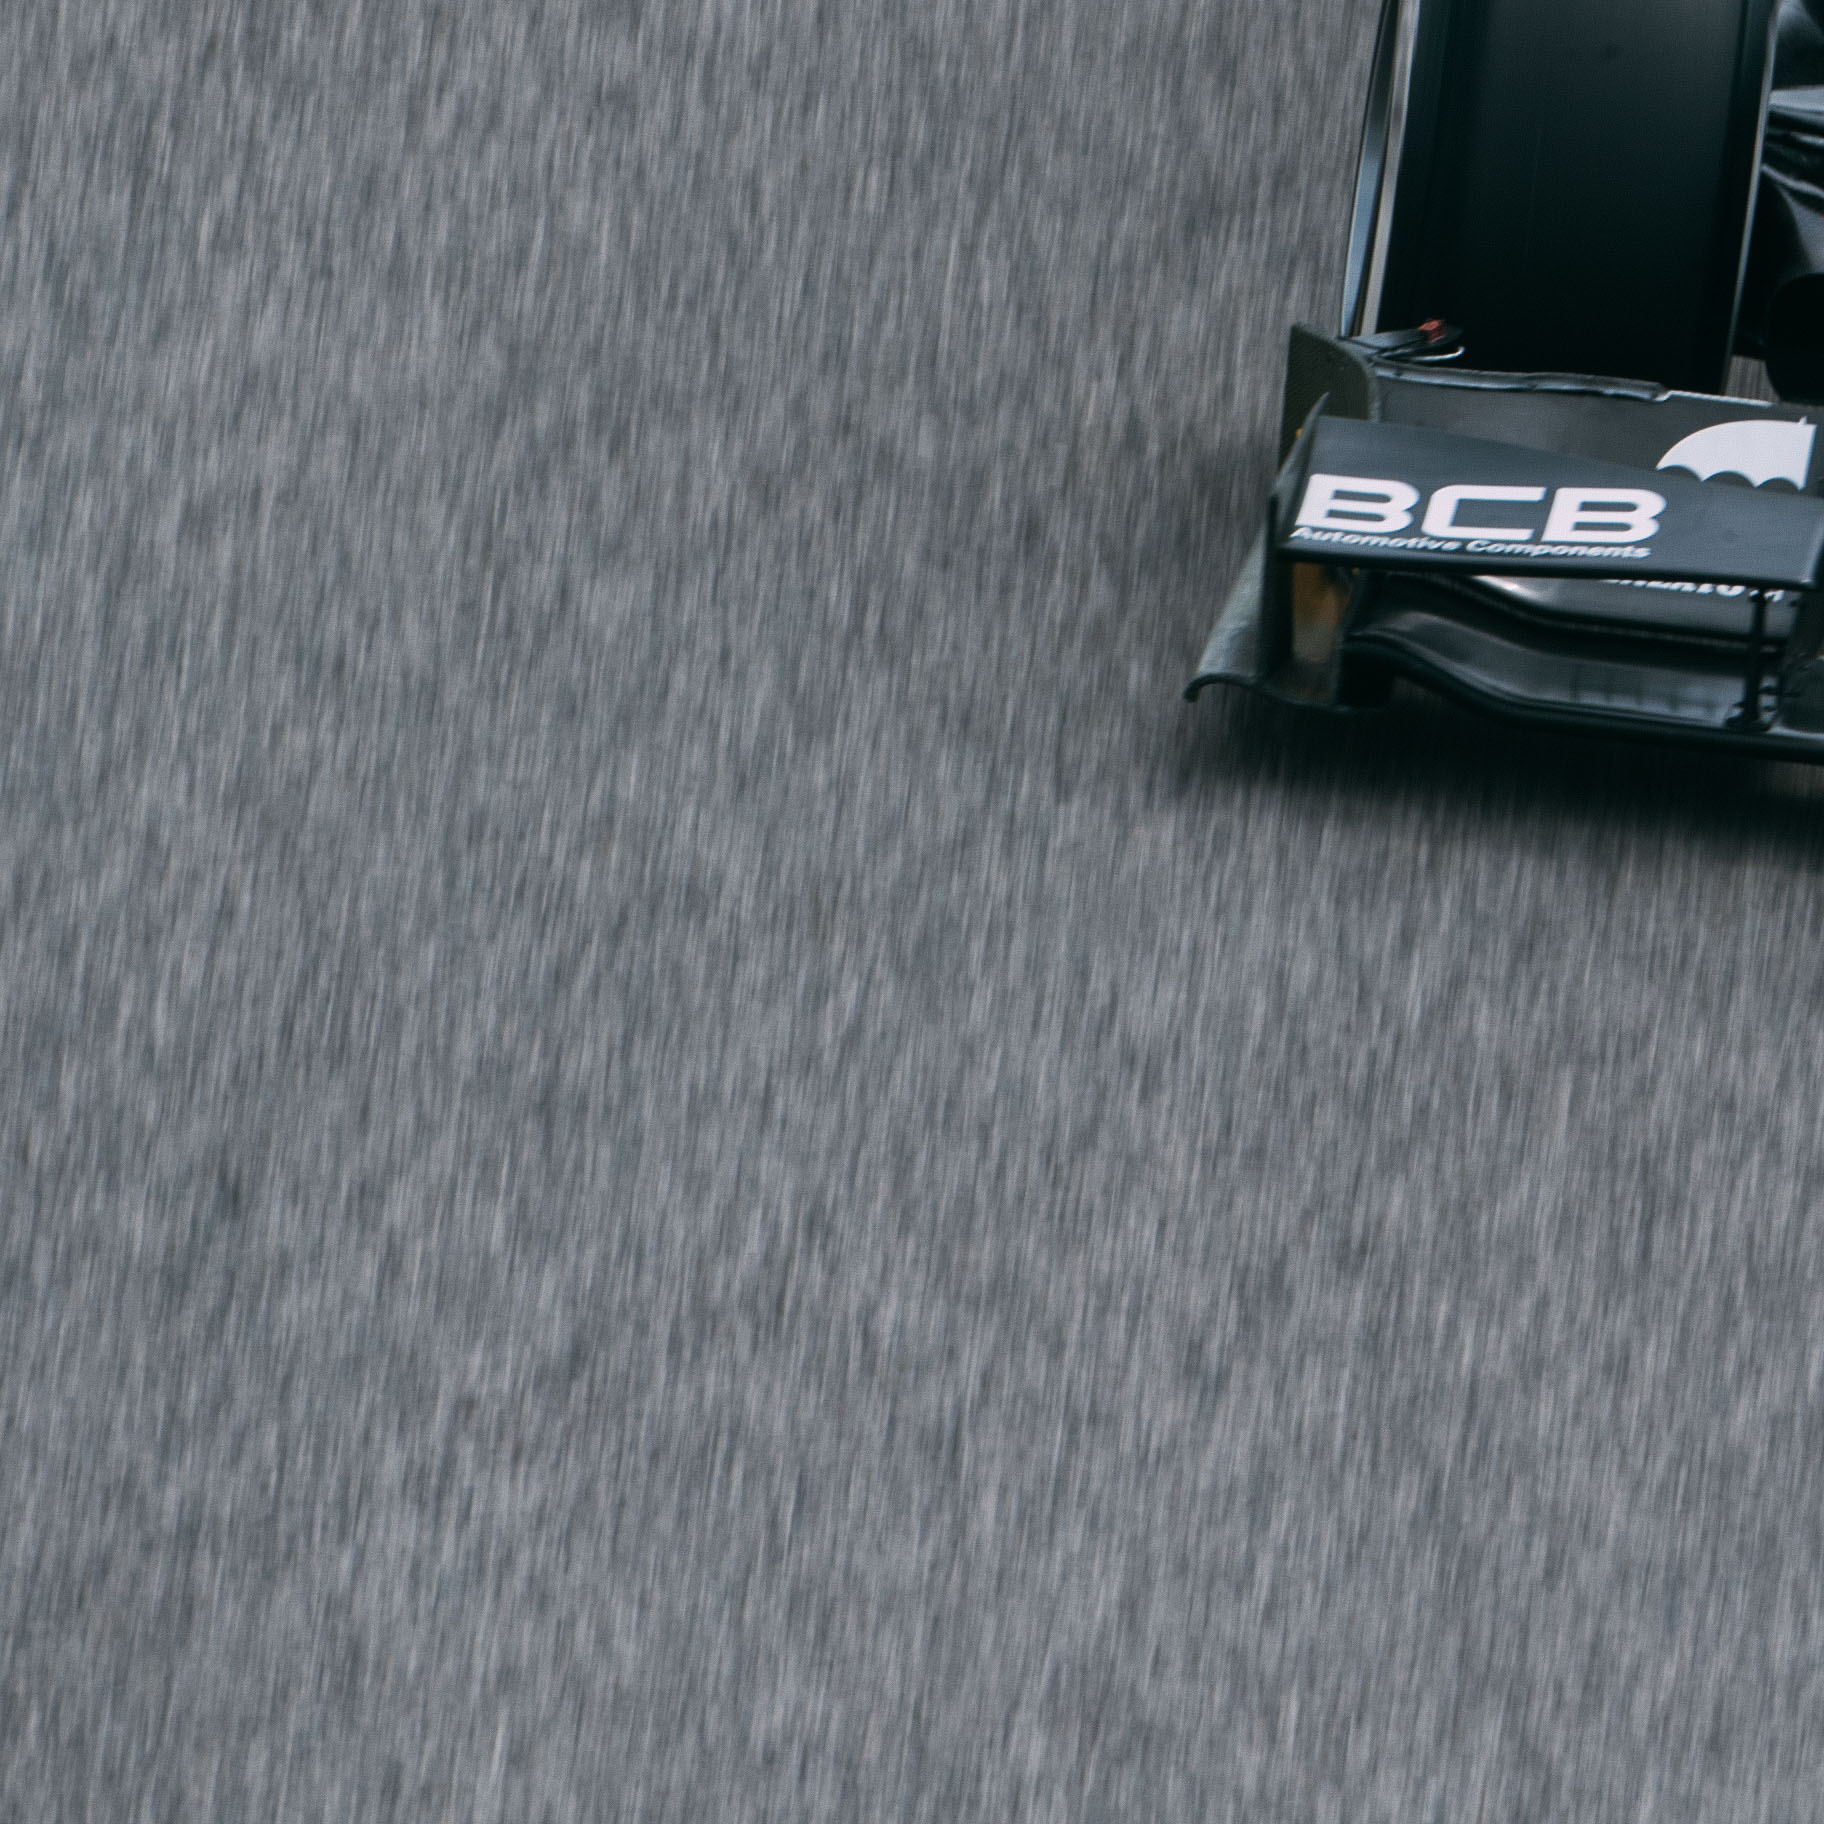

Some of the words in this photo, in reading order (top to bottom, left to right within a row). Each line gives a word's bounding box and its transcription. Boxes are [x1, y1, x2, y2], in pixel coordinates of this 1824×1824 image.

[1295, 473, 1667, 544] BCB
[1289, 526, 1463, 552] Automotive
[1466, 539, 1651, 559] Components
